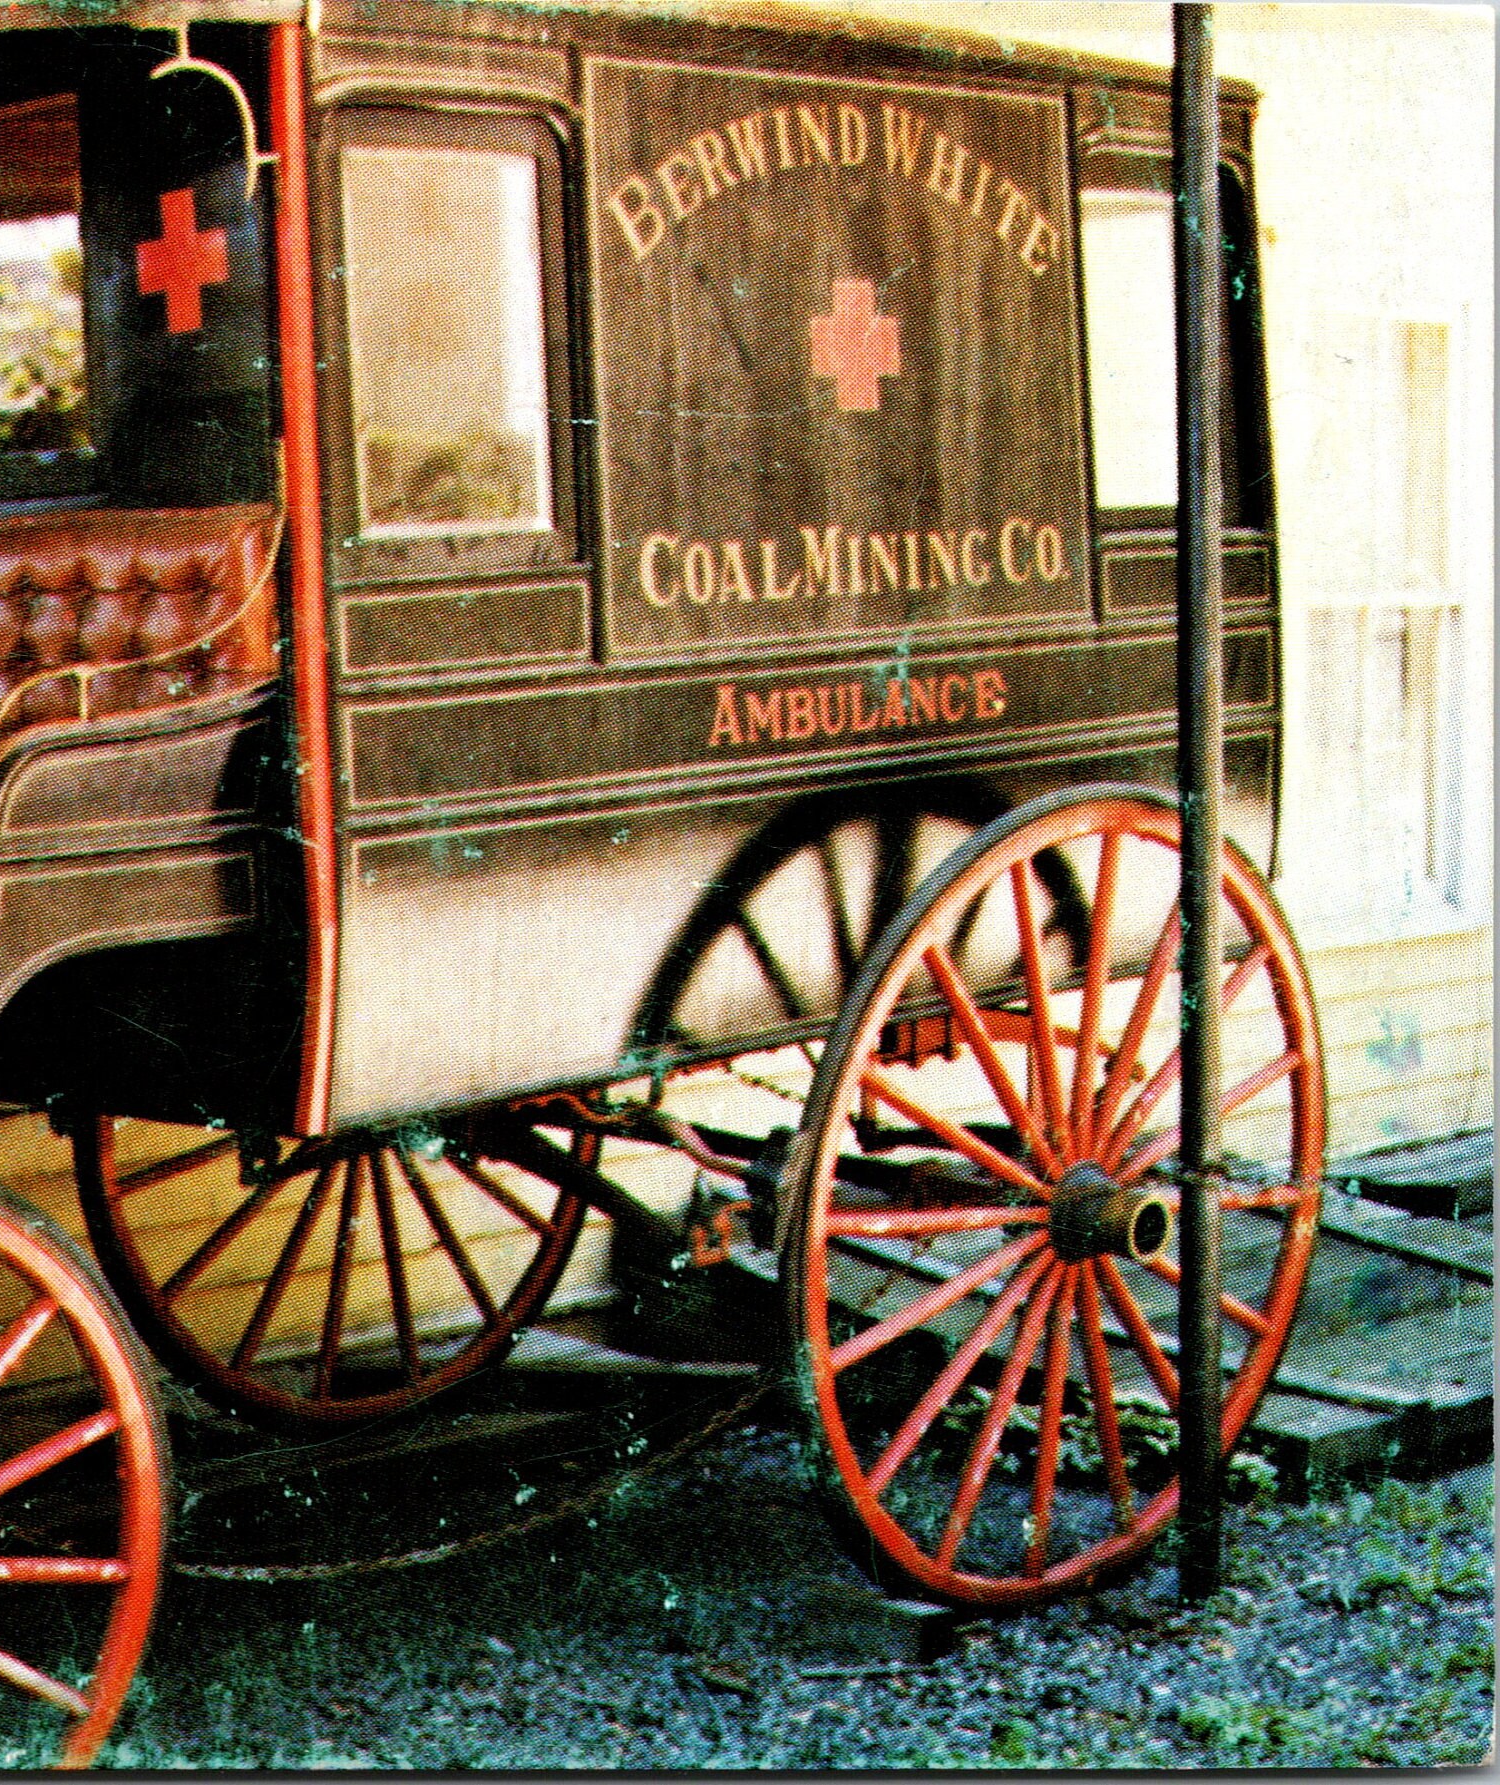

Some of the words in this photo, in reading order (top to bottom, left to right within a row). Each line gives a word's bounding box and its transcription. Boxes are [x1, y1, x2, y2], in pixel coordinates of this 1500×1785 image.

[606, 102, 867, 261] BERWIND
[882, 104, 1061, 276] WHITE
[640, 531, 799, 607] COAL
[800, 523, 991, 597] MINING
[708, 669, 1008, 747] AMBULANCE
